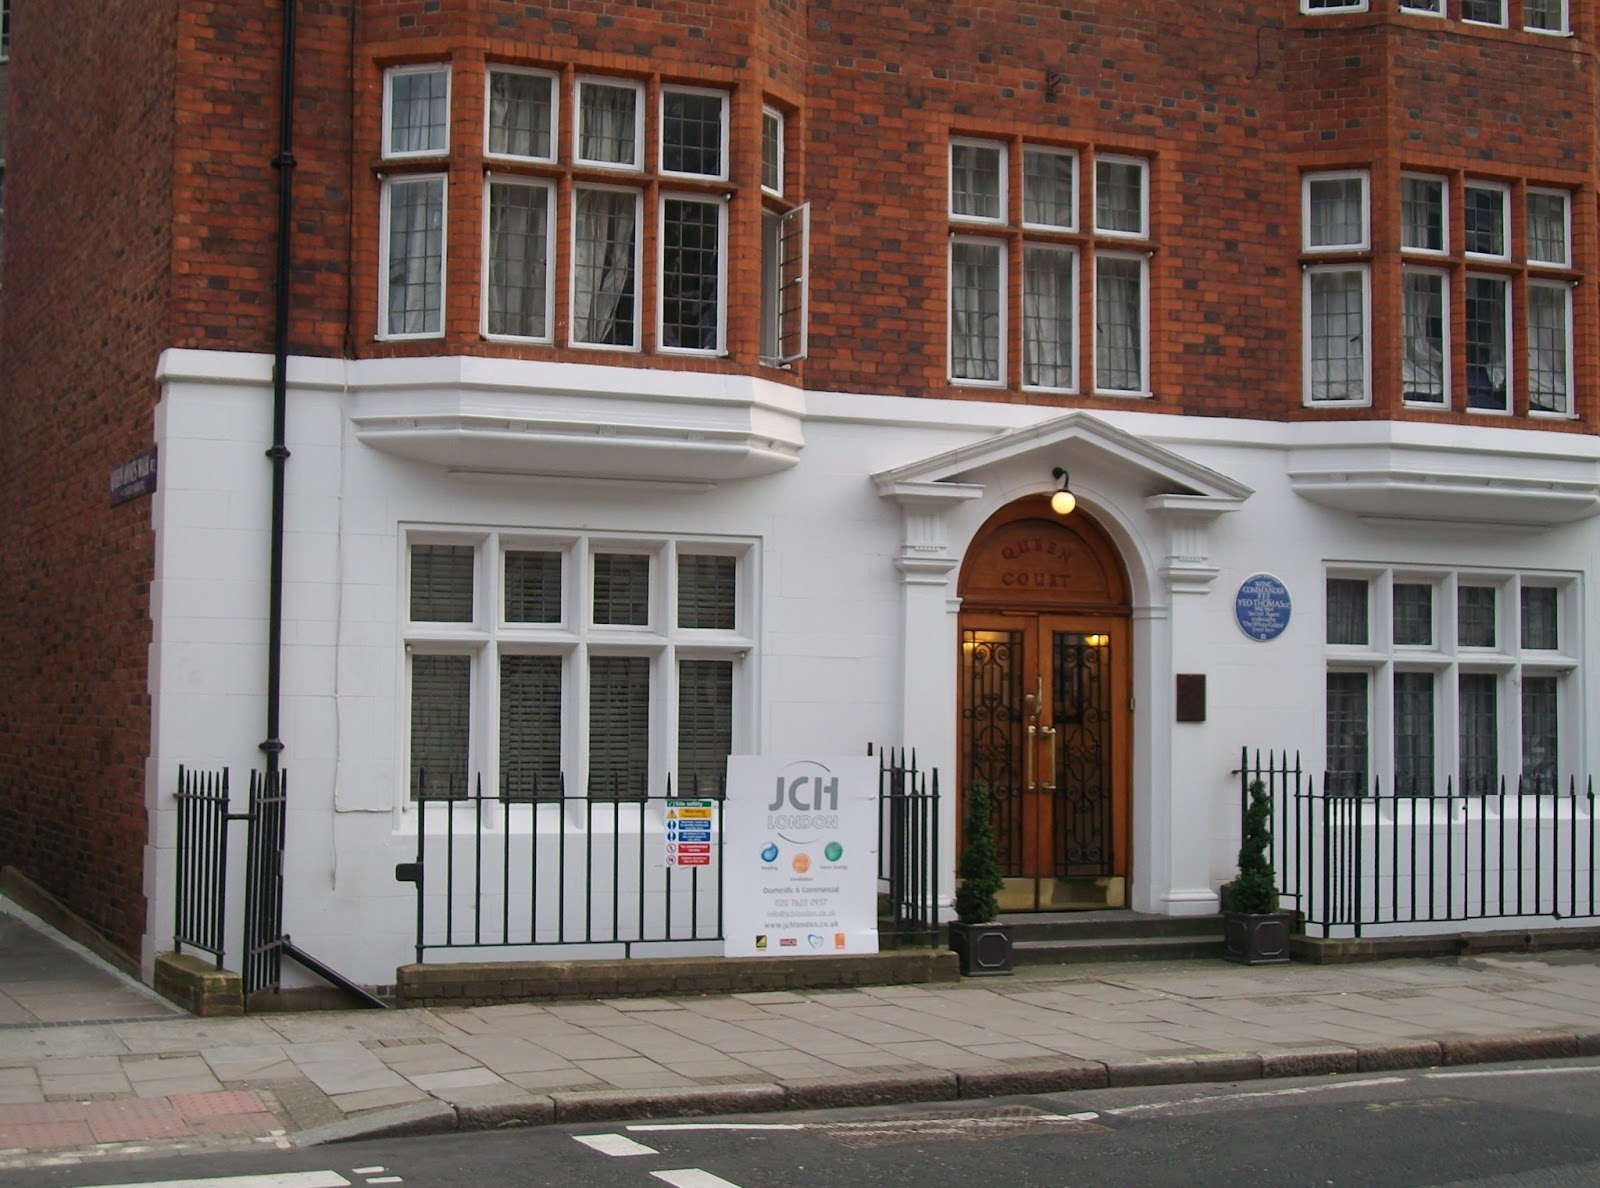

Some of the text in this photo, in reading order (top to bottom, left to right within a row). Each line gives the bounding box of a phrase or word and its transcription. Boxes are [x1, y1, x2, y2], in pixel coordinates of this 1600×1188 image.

[1002, 540, 1072, 560] QUEEN
[1002, 572, 1072, 588] COURT
[1242, 586, 1285, 594] COMMANDER
[768, 776, 839, 811] JCH
[767, 814, 839, 829] LONDON
[763, 886, 794, 894] Domestic
[802, 885, 840, 894] Commercial
[774, 898, 789, 907] 020
